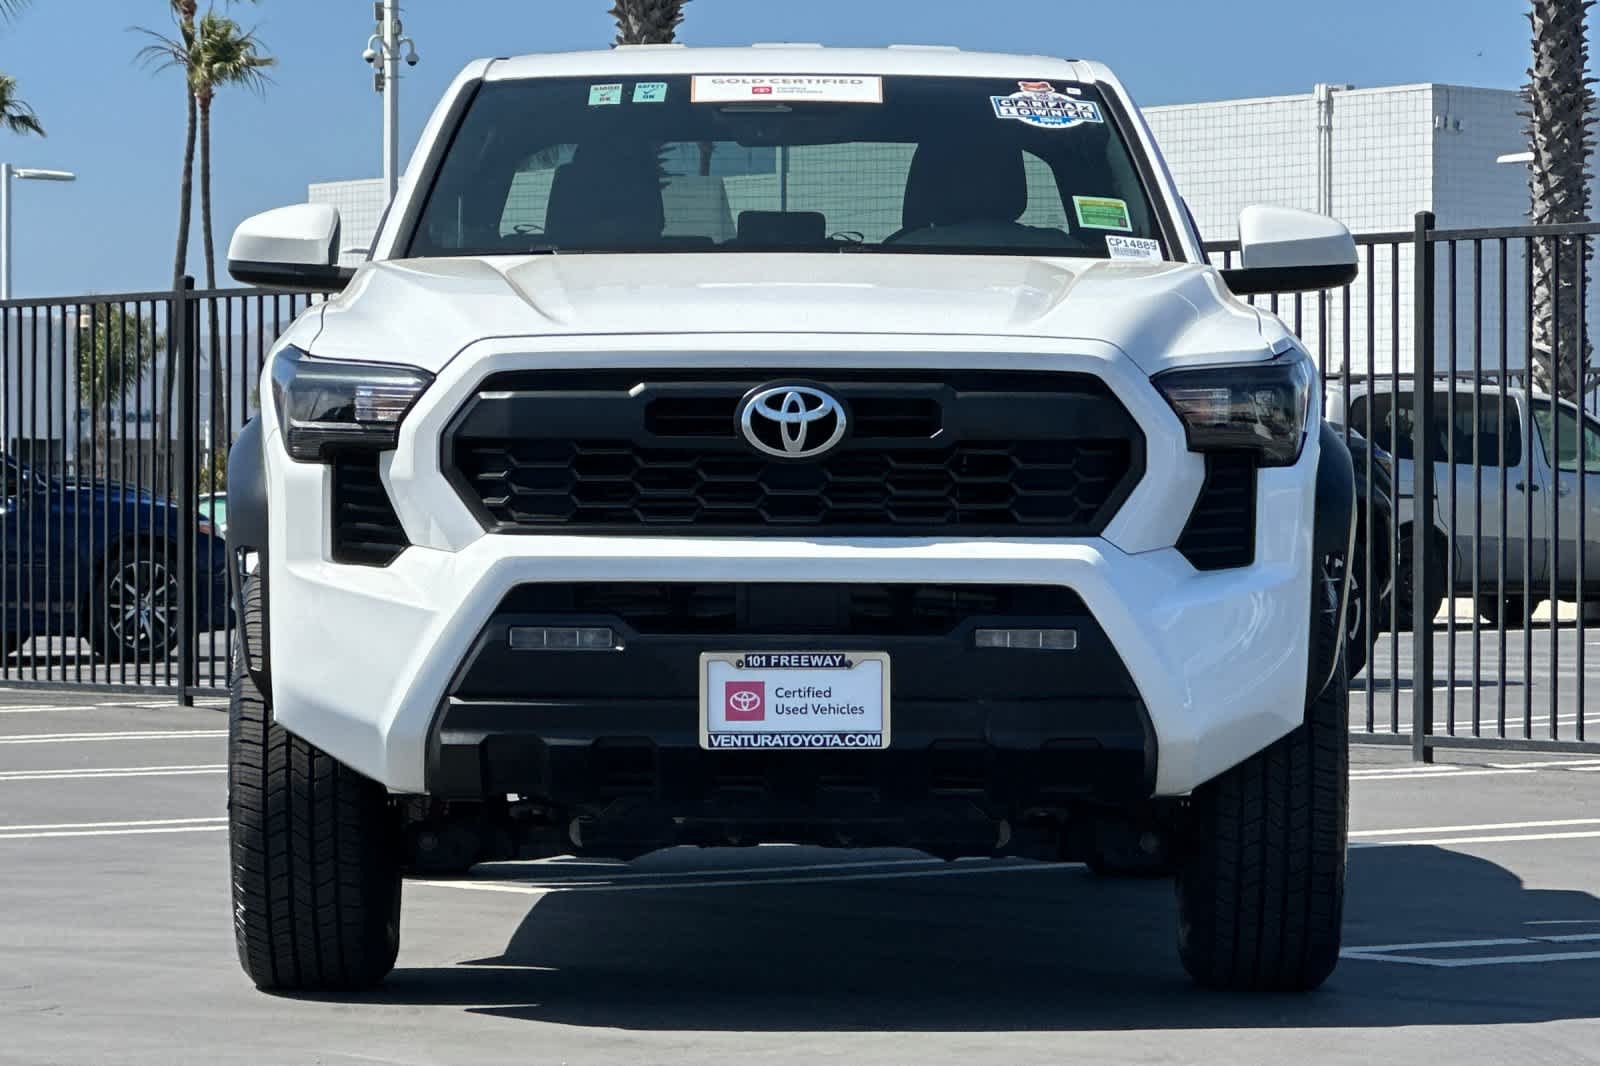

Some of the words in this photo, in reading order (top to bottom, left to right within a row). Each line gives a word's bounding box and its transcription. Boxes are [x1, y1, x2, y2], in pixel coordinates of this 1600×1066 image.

[1000, 99, 1090, 112] CARFAX
[1020, 108, 1095, 119] OWNER
[746, 655, 766, 667] 101
[771, 655, 842, 667] FREEWAY
[774, 686, 832, 698] Certified
[775, 703, 808, 715] Used
[811, 703, 865, 715] Vehicles
[710, 734, 881, 747] VENTURATOYOTA.COM
